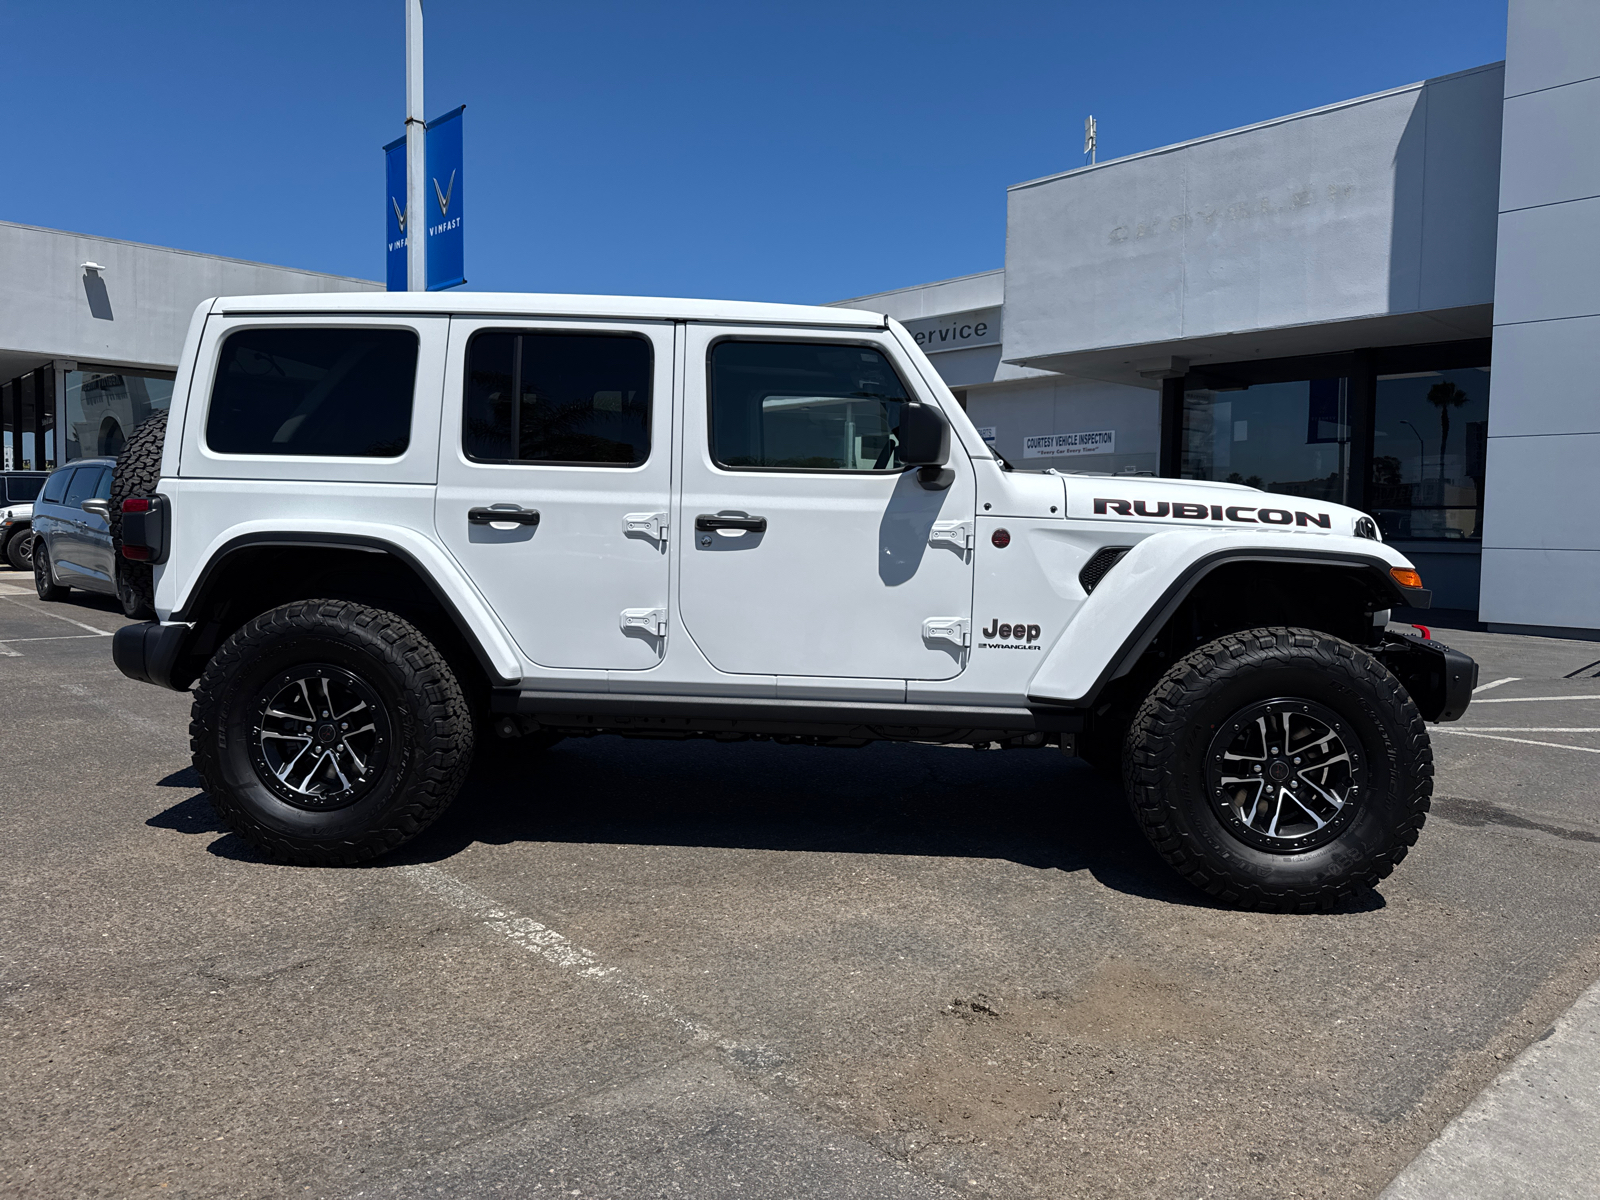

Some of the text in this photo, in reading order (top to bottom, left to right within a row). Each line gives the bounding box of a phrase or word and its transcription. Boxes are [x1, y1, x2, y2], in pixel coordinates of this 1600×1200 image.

[429, 217, 460, 236] VINFAST
[388, 237, 408, 252] VINFA
[908, 321, 988, 346] ervice
[1026, 432, 1112, 449] COURTESY VEHICLE INSPECTION
[1093, 497, 1332, 529] RUBICON
[982, 618, 1042, 644] Jeep
[987, 643, 1041, 651] WRANGLER
[1329, 680, 1398, 811] BFGoodrich
